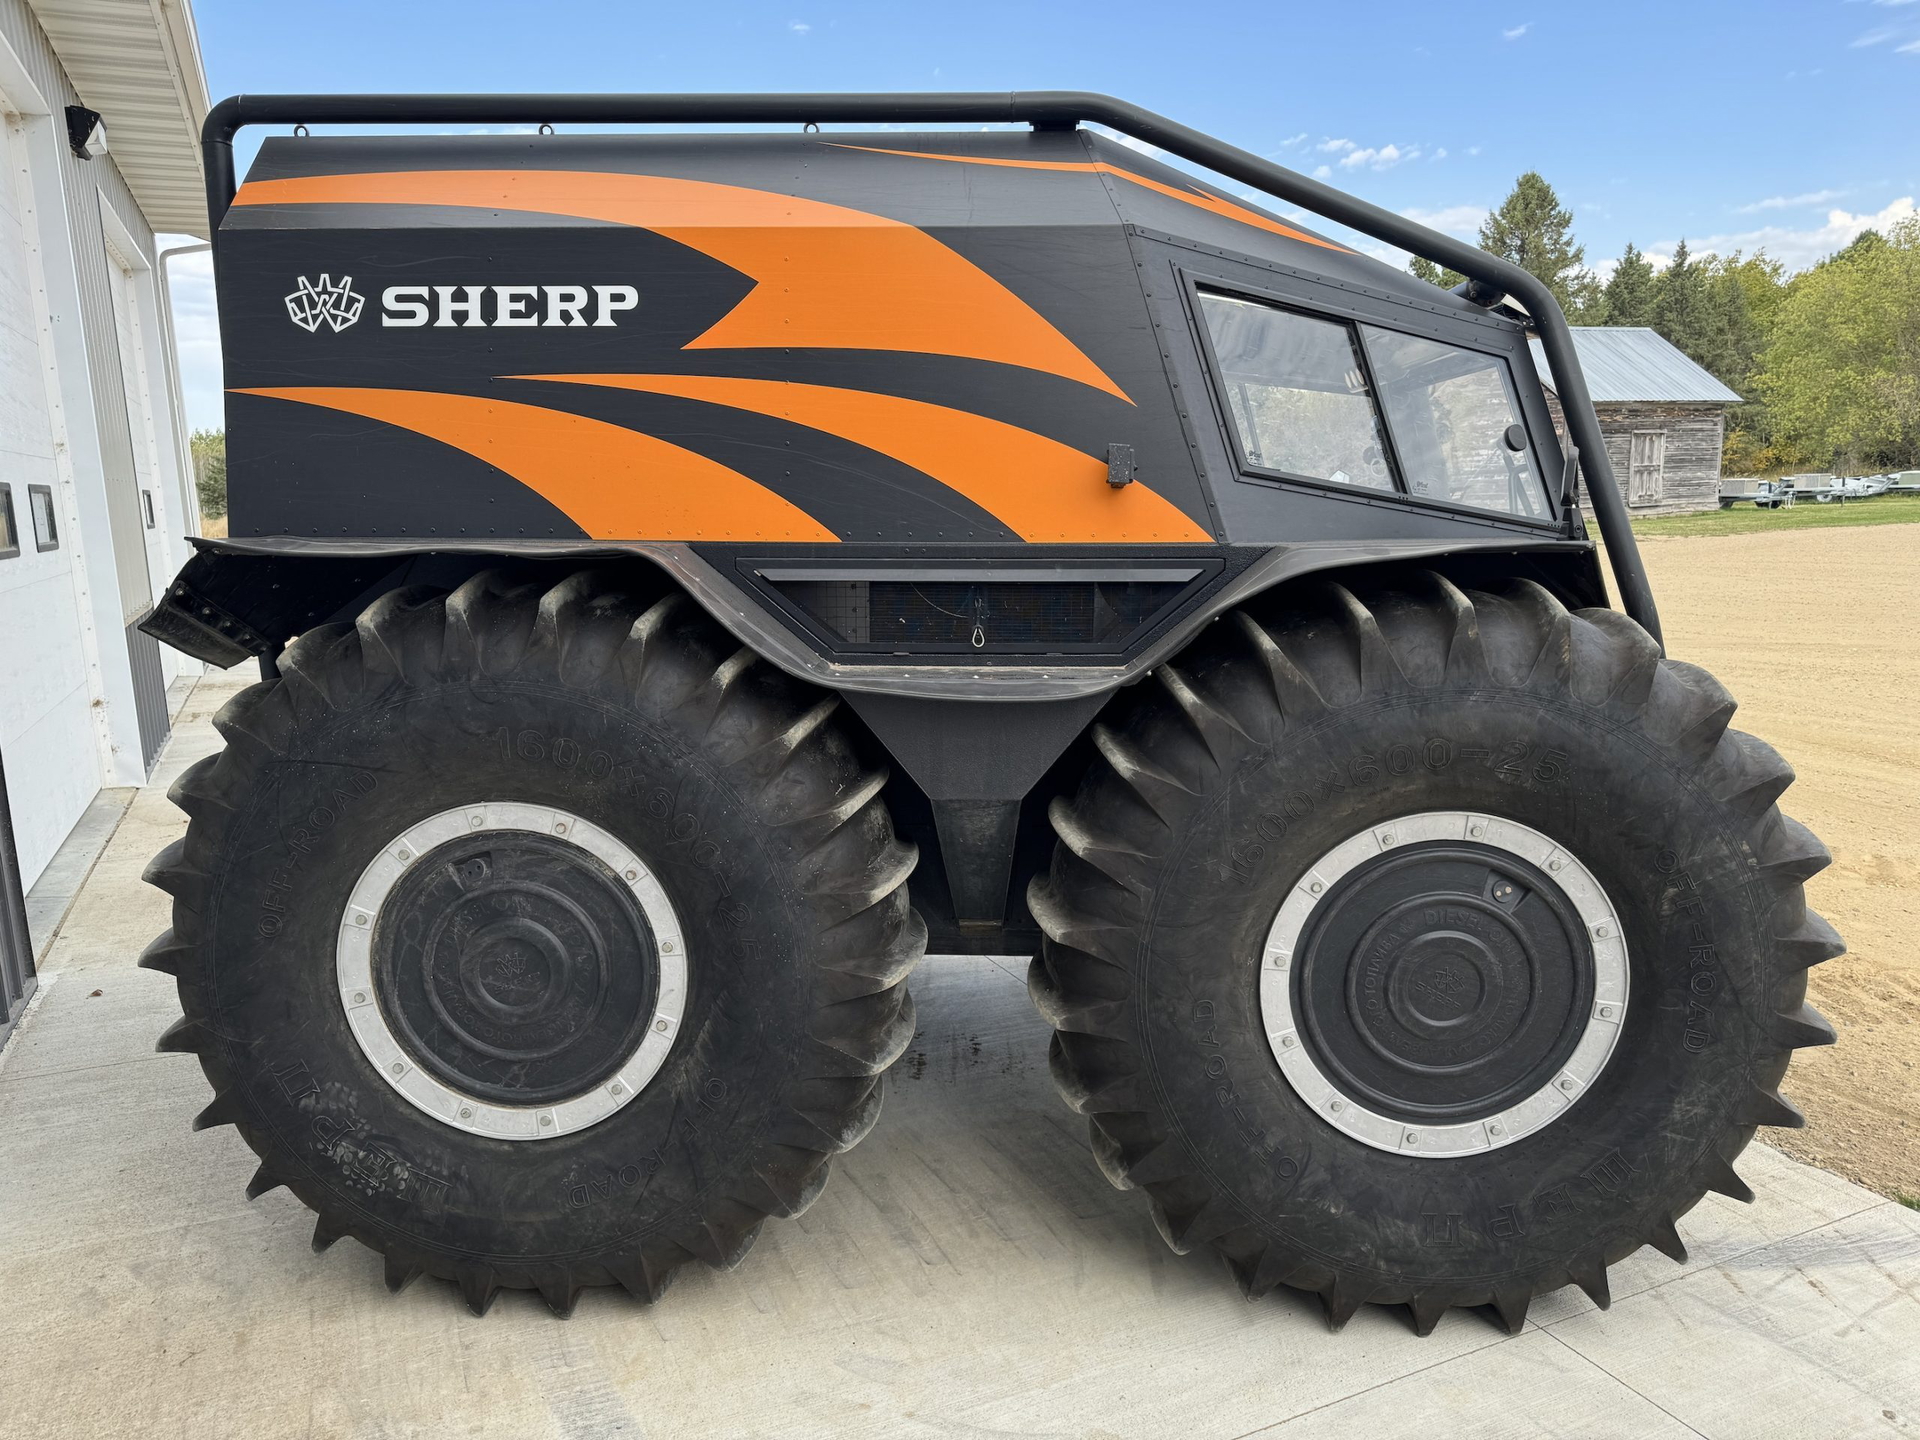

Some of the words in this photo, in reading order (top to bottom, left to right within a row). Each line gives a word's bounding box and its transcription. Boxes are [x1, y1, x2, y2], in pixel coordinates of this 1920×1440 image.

[381, 285, 639, 327] SHERP
[257, 769, 379, 938] OFF-ROAD
[1422, 908, 1482, 931] DIESEL
[1653, 849, 1717, 1053] OFF-ROAD
[568, 1078, 728, 1209] OFF-ROAD
[1193, 1000, 1298, 1181] OFF-ROAD
